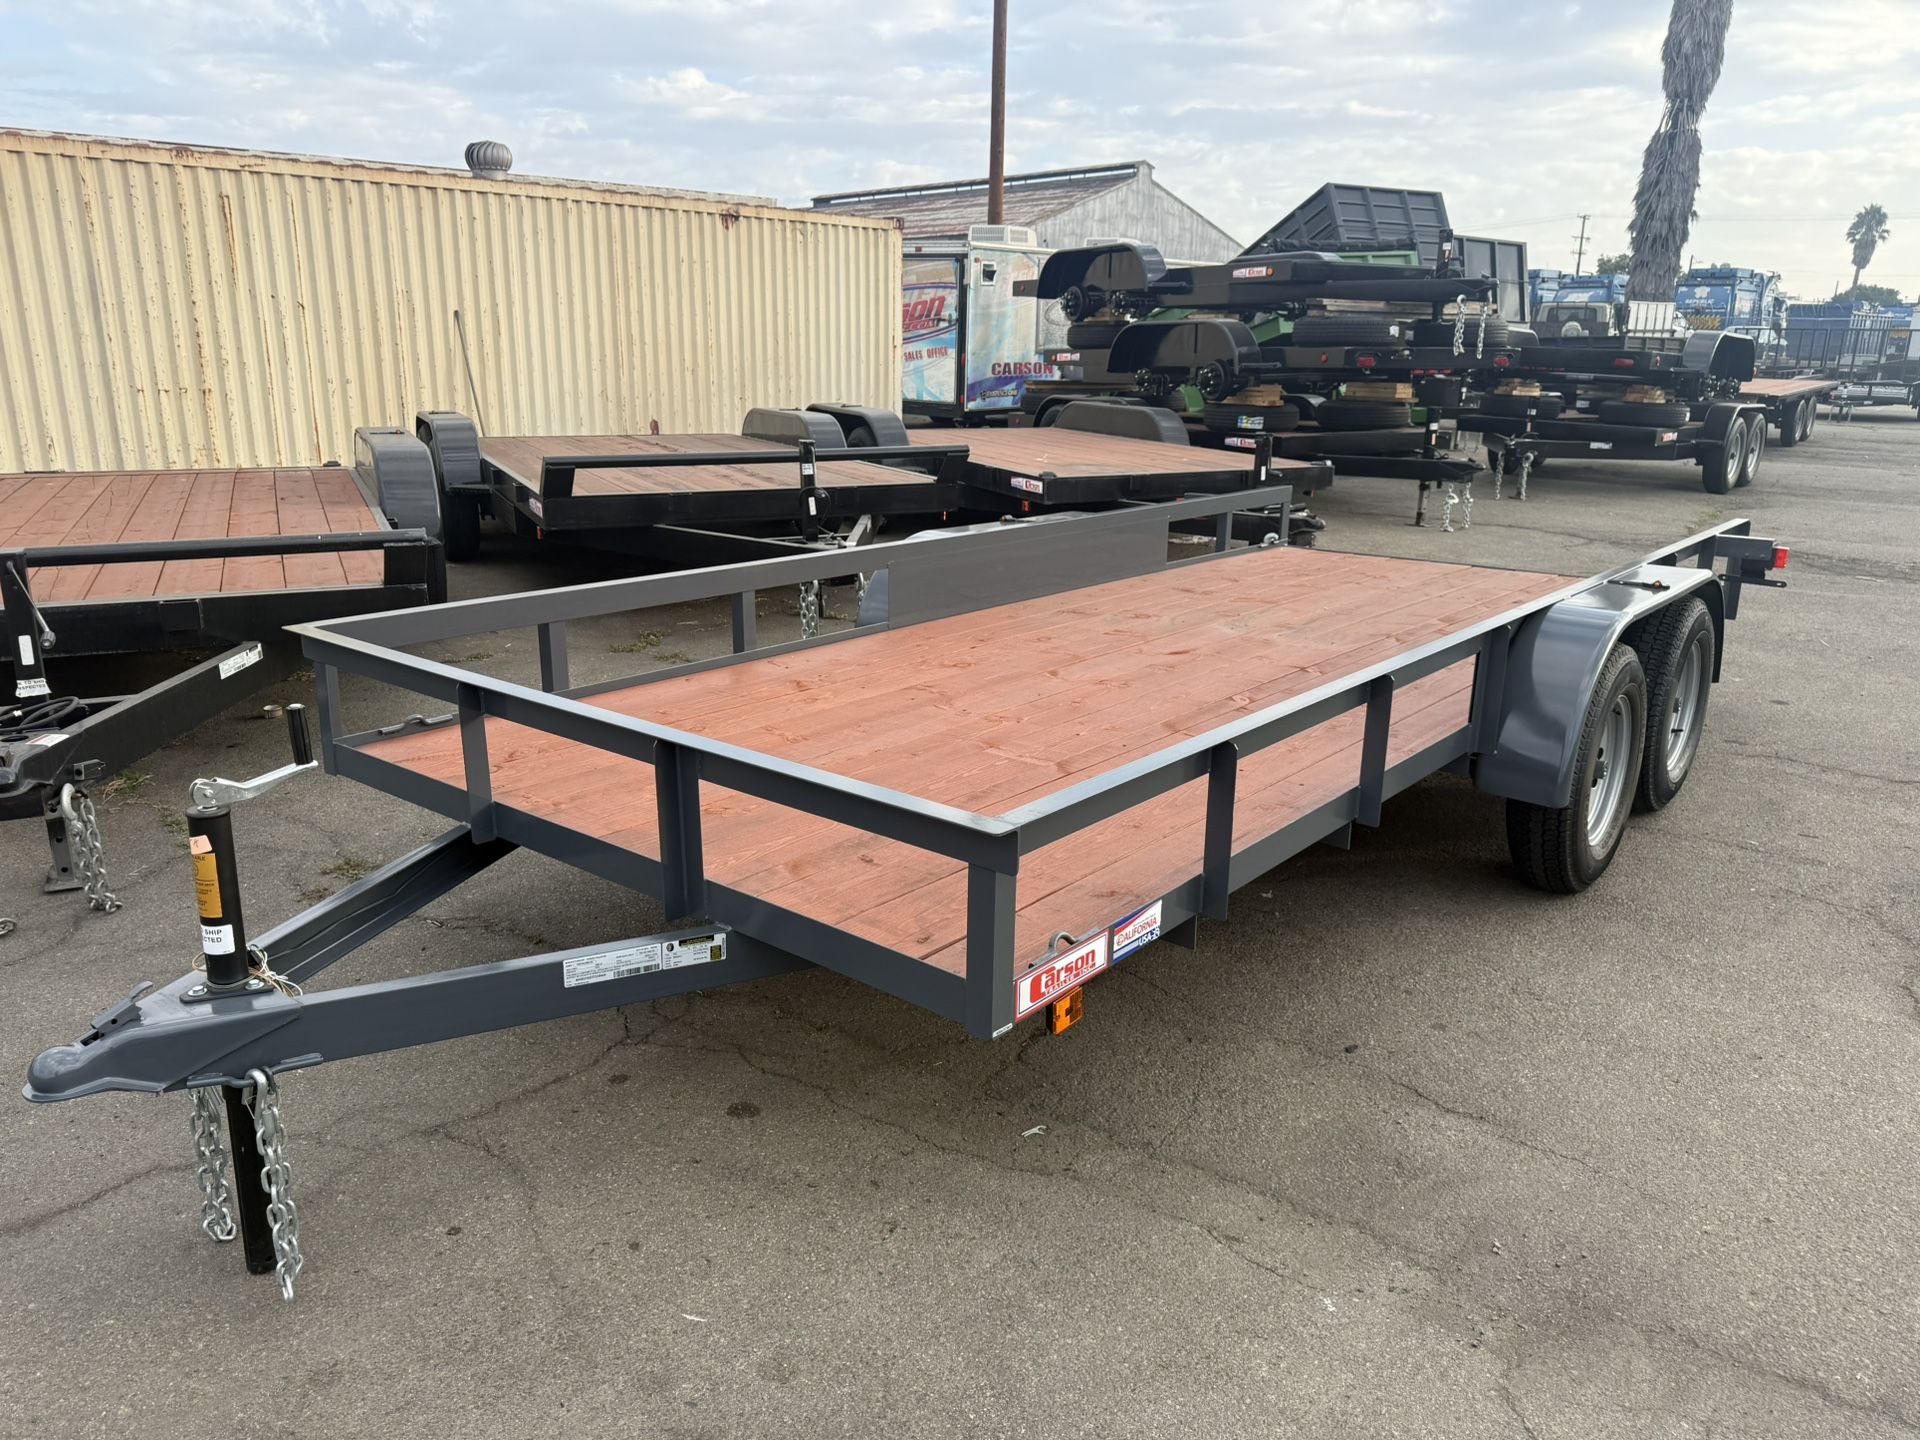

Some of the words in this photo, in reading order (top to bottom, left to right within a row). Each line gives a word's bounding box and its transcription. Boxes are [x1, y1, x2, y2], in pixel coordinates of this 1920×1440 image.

[904, 350, 923, 362] SALES
[927, 346, 948, 358] OFFICE
[991, 362, 1053, 376] CARSON
[1116, 917, 1157, 947] CALIFORNIA
[1030, 949, 1095, 1003] Carson
